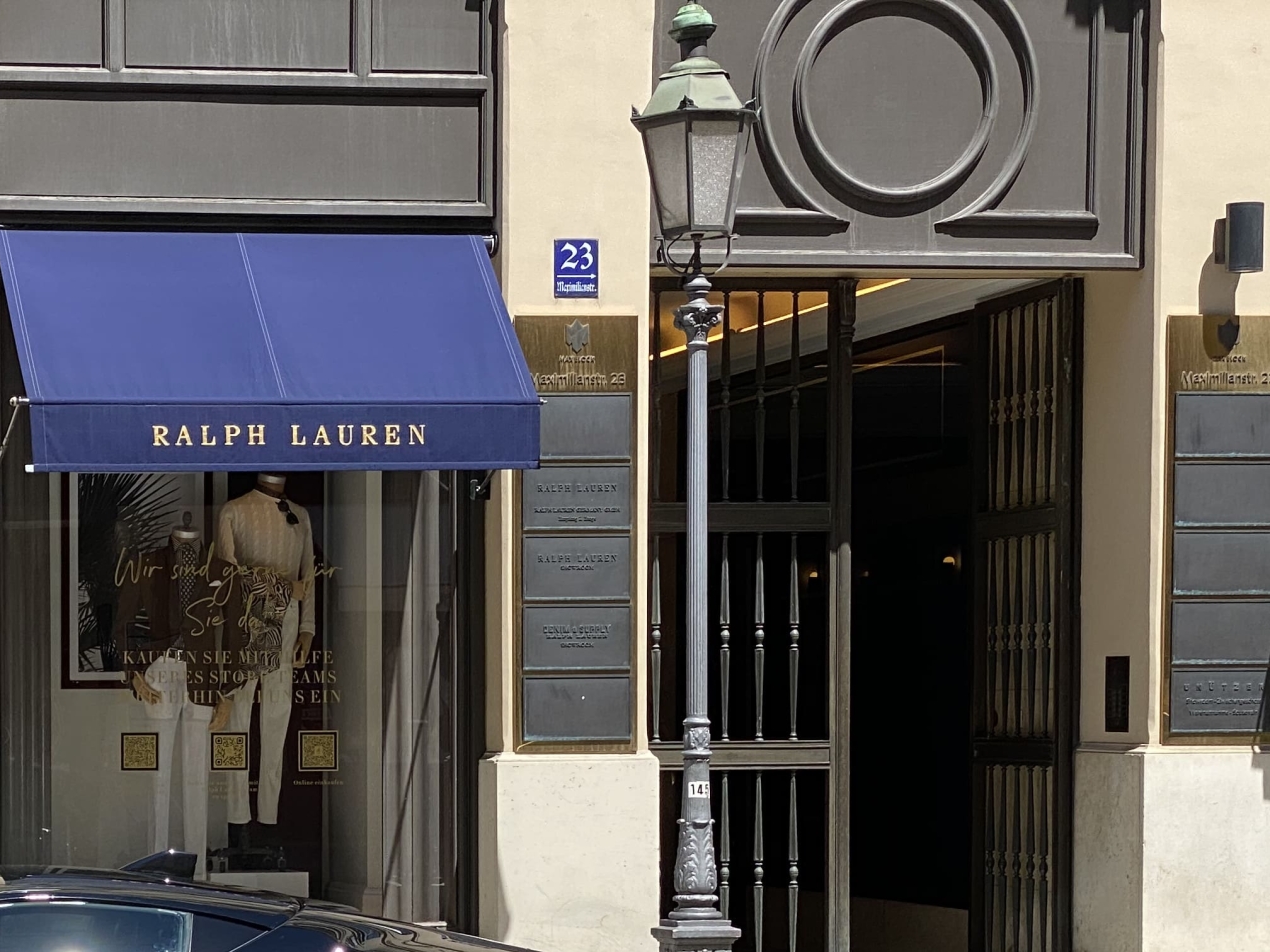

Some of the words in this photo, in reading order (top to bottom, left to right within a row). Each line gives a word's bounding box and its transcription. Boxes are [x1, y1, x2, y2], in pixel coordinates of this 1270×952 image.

[560, 242, 594, 270] 23
[1181, 371, 1258, 385] Maximilianstr.
[1261, 372, 1270, 385] 2
[152, 424, 266, 447] RALPH
[290, 424, 426, 446] LAUREN
[537, 484, 572, 493] RALPH
[577, 484, 618, 493] LAUREN
[537, 554, 572, 563] RALPH
[577, 554, 618, 563] LAUREN
[114, 546, 163, 587] Wir
[170, 541, 215, 582] sind
[303, 554, 343, 596] für
[185, 597, 228, 637] Sie
[122, 650, 198, 665] KAUFEN
[202, 650, 232, 664] SIE
[238, 650, 271, 664] MIT
[310, 689, 342, 704] EIN
